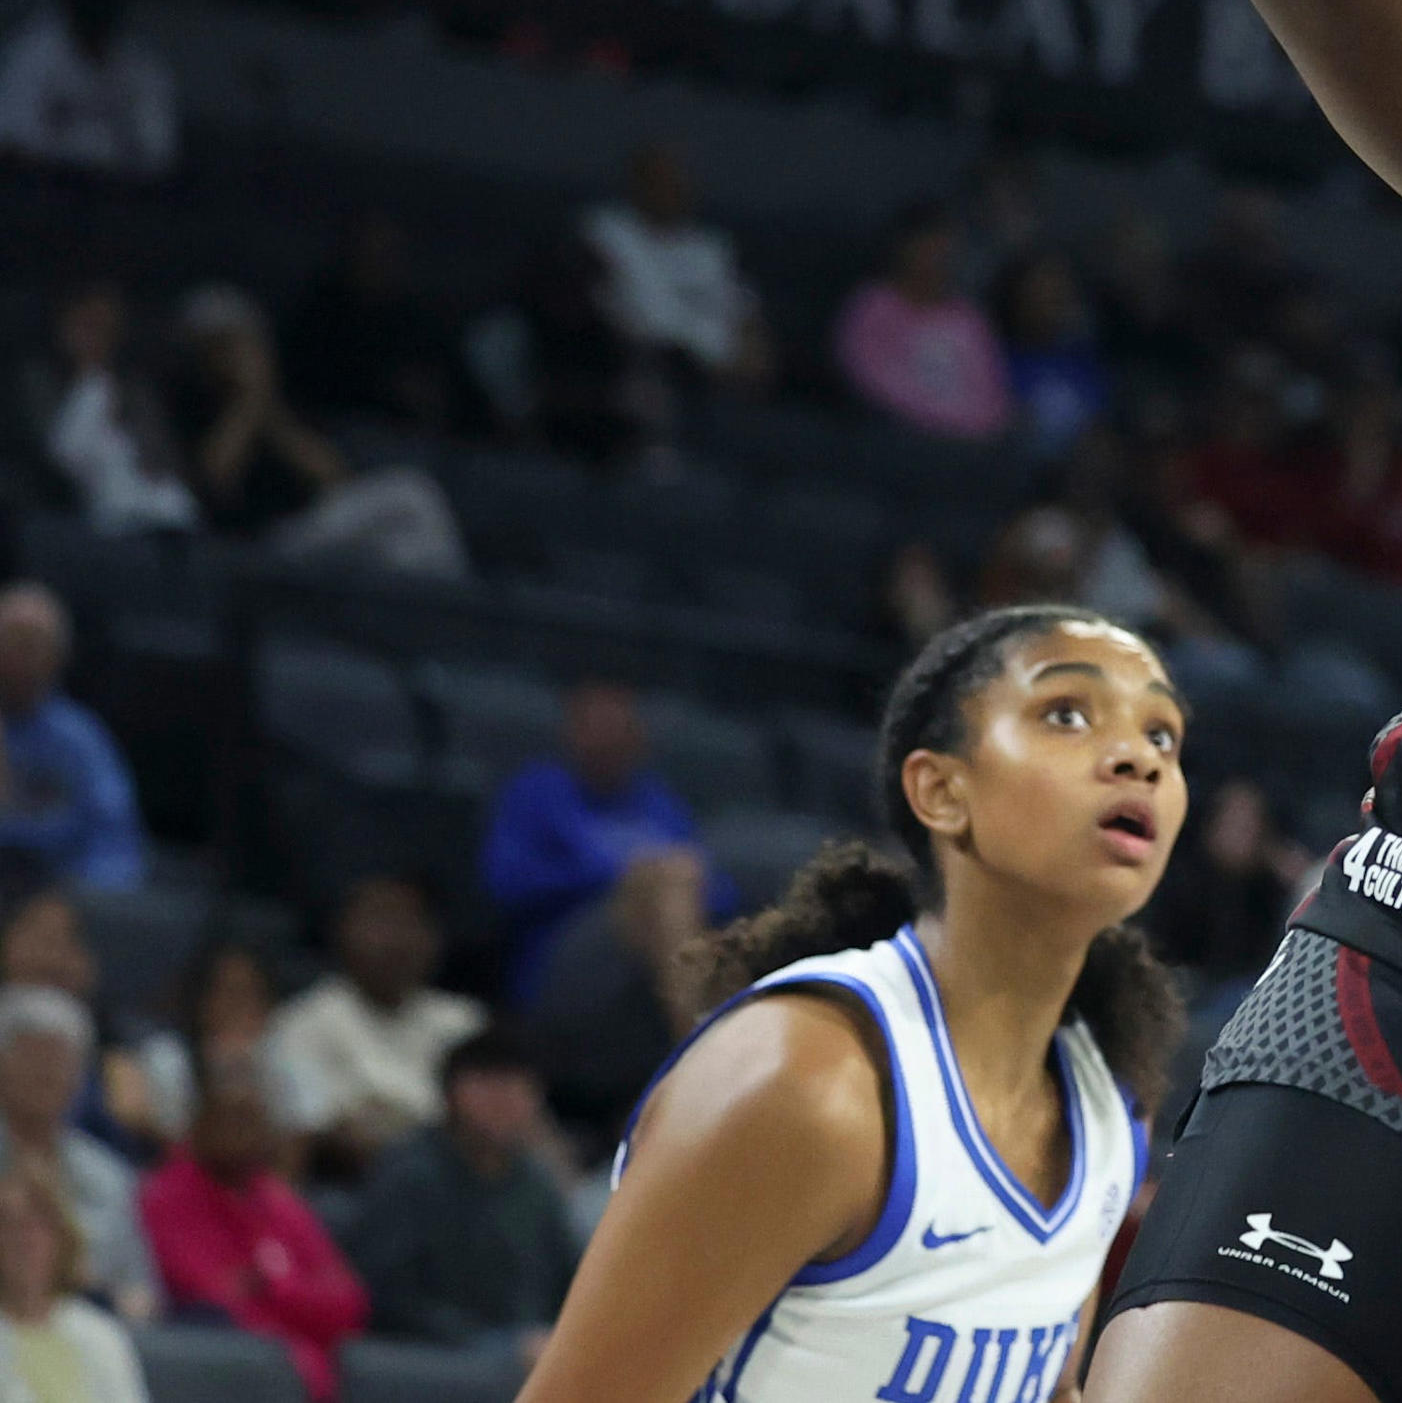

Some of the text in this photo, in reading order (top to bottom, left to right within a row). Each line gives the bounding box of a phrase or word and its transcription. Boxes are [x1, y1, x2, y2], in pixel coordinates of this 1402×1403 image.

[1343, 826, 1382, 892] 4
[1218, 1246, 1350, 1304] UNDER ARMOUR
[876, 1315, 1079, 1403] DUK
